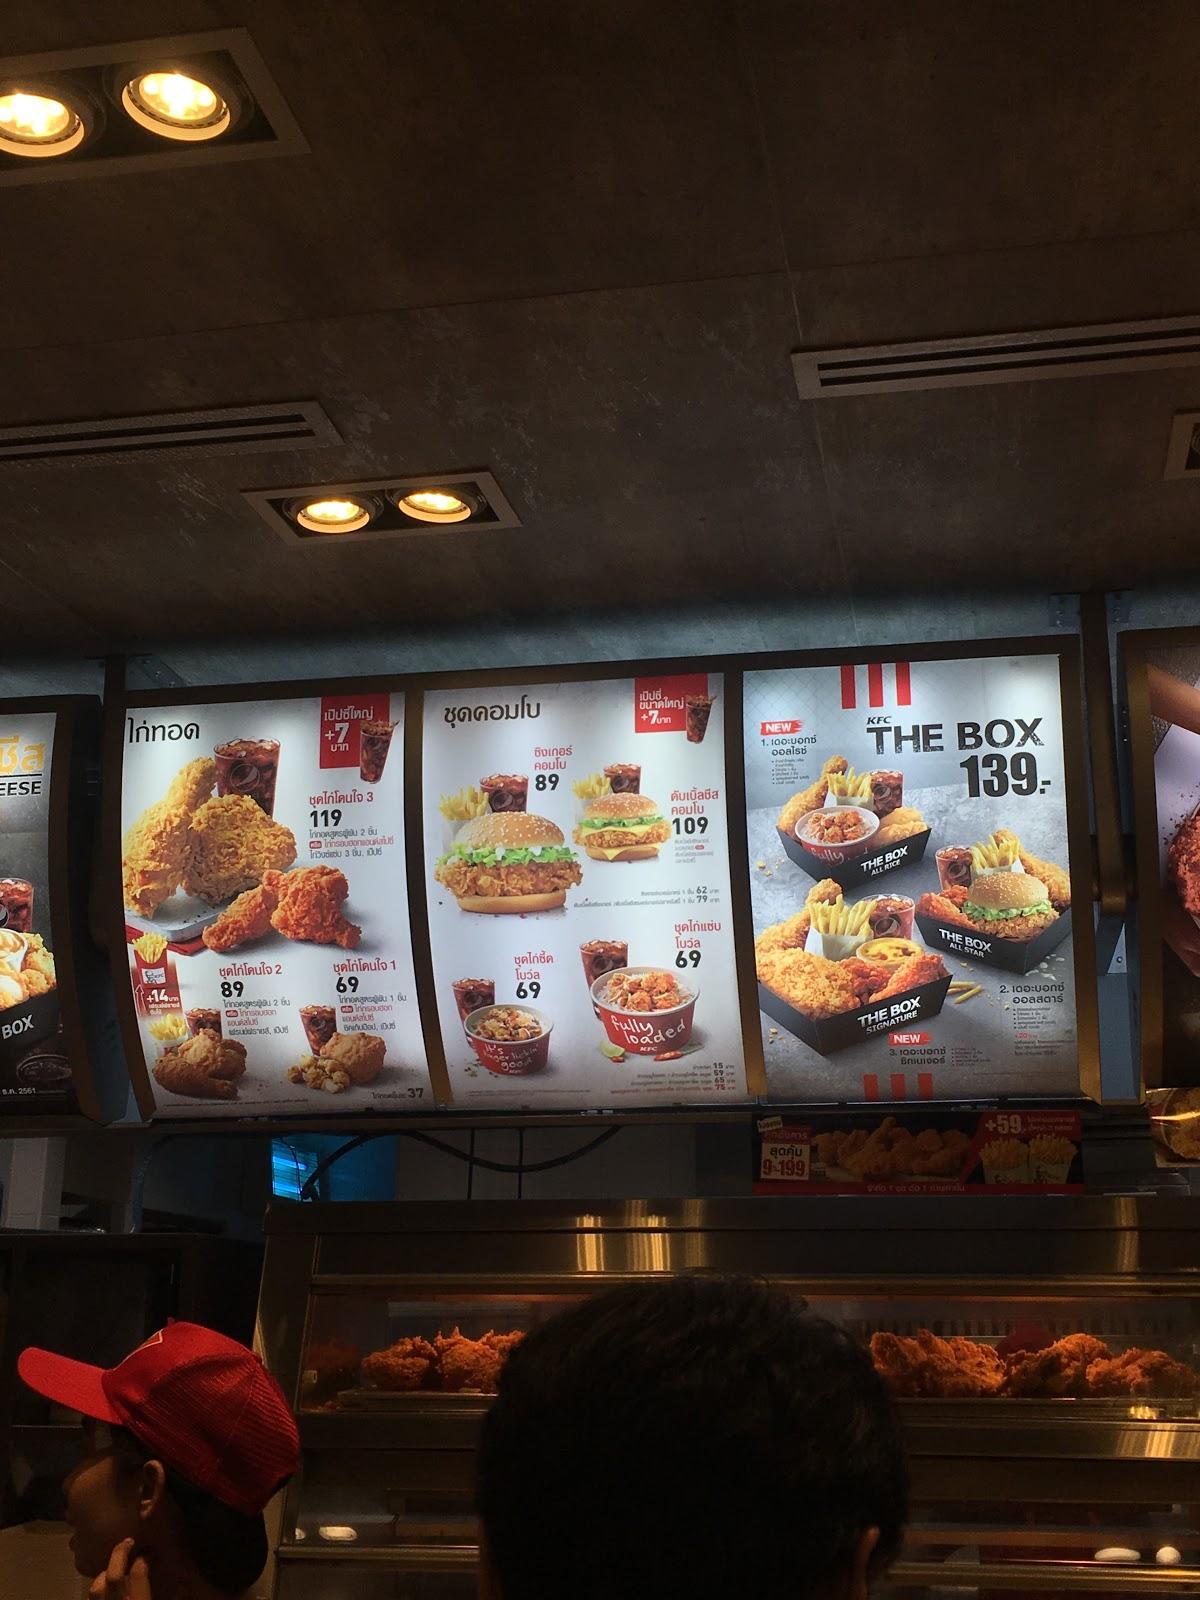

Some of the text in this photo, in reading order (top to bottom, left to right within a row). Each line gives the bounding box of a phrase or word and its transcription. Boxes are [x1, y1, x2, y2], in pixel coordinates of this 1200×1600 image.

[444, 694, 541, 728] ชุดคอมโบ
[639, 697, 684, 710] ขนาดใหญ่
[765, 722, 792, 733] NEW
[866, 716, 892, 725] KFC
[127, 717, 200, 743] ไก่ทอด
[324, 723, 350, 744] +7
[866, 717, 1045, 755] THE BOX
[330, 743, 349, 752] บาท
[534, 757, 567, 770] คอมโบ
[535, 773, 560, 791] 89
[309, 789, 374, 808] ชุดไก่โดนใจ 3
[671, 801, 705, 815] คอมโบ
[310, 809, 342, 828] 119
[672, 816, 709, 835] 109
[861, 856, 884, 872] THE
[884, 845, 908, 861] BOX
[871, 859, 900, 876] ALL RICE
[696, 886, 707, 894] 62
[696, 895, 708, 903] 79
[674, 919, 721, 935] ชุดไก่แซ่บ
[675, 936, 701, 949] โบว์ล
[938, 928, 992, 953] THE BOX
[949, 942, 985, 958] ALL STAR
[333, 957, 396, 976] ชุดไก่โดนใจ 1
[675, 950, 702, 969] 69
[219, 962, 282, 980] ชุดไก่โดนใจ 2
[515, 969, 540, 981] โบว์ล
[220, 981, 244, 998] 89
[336, 976, 359, 993] 69
[516, 981, 541, 999] 69
[999, 984, 1010, 994] 2.
[857, 995, 921, 1028] THE BOX
[2, 1014, 34, 1039] BOX
[610, 1014, 653, 1036] fully
[624, 1018, 686, 1044] loaded
[865, 1010, 918, 1034] SIGNATURE
[893, 1034, 921, 1044] NEW
[408, 1087, 424, 1098] 37
